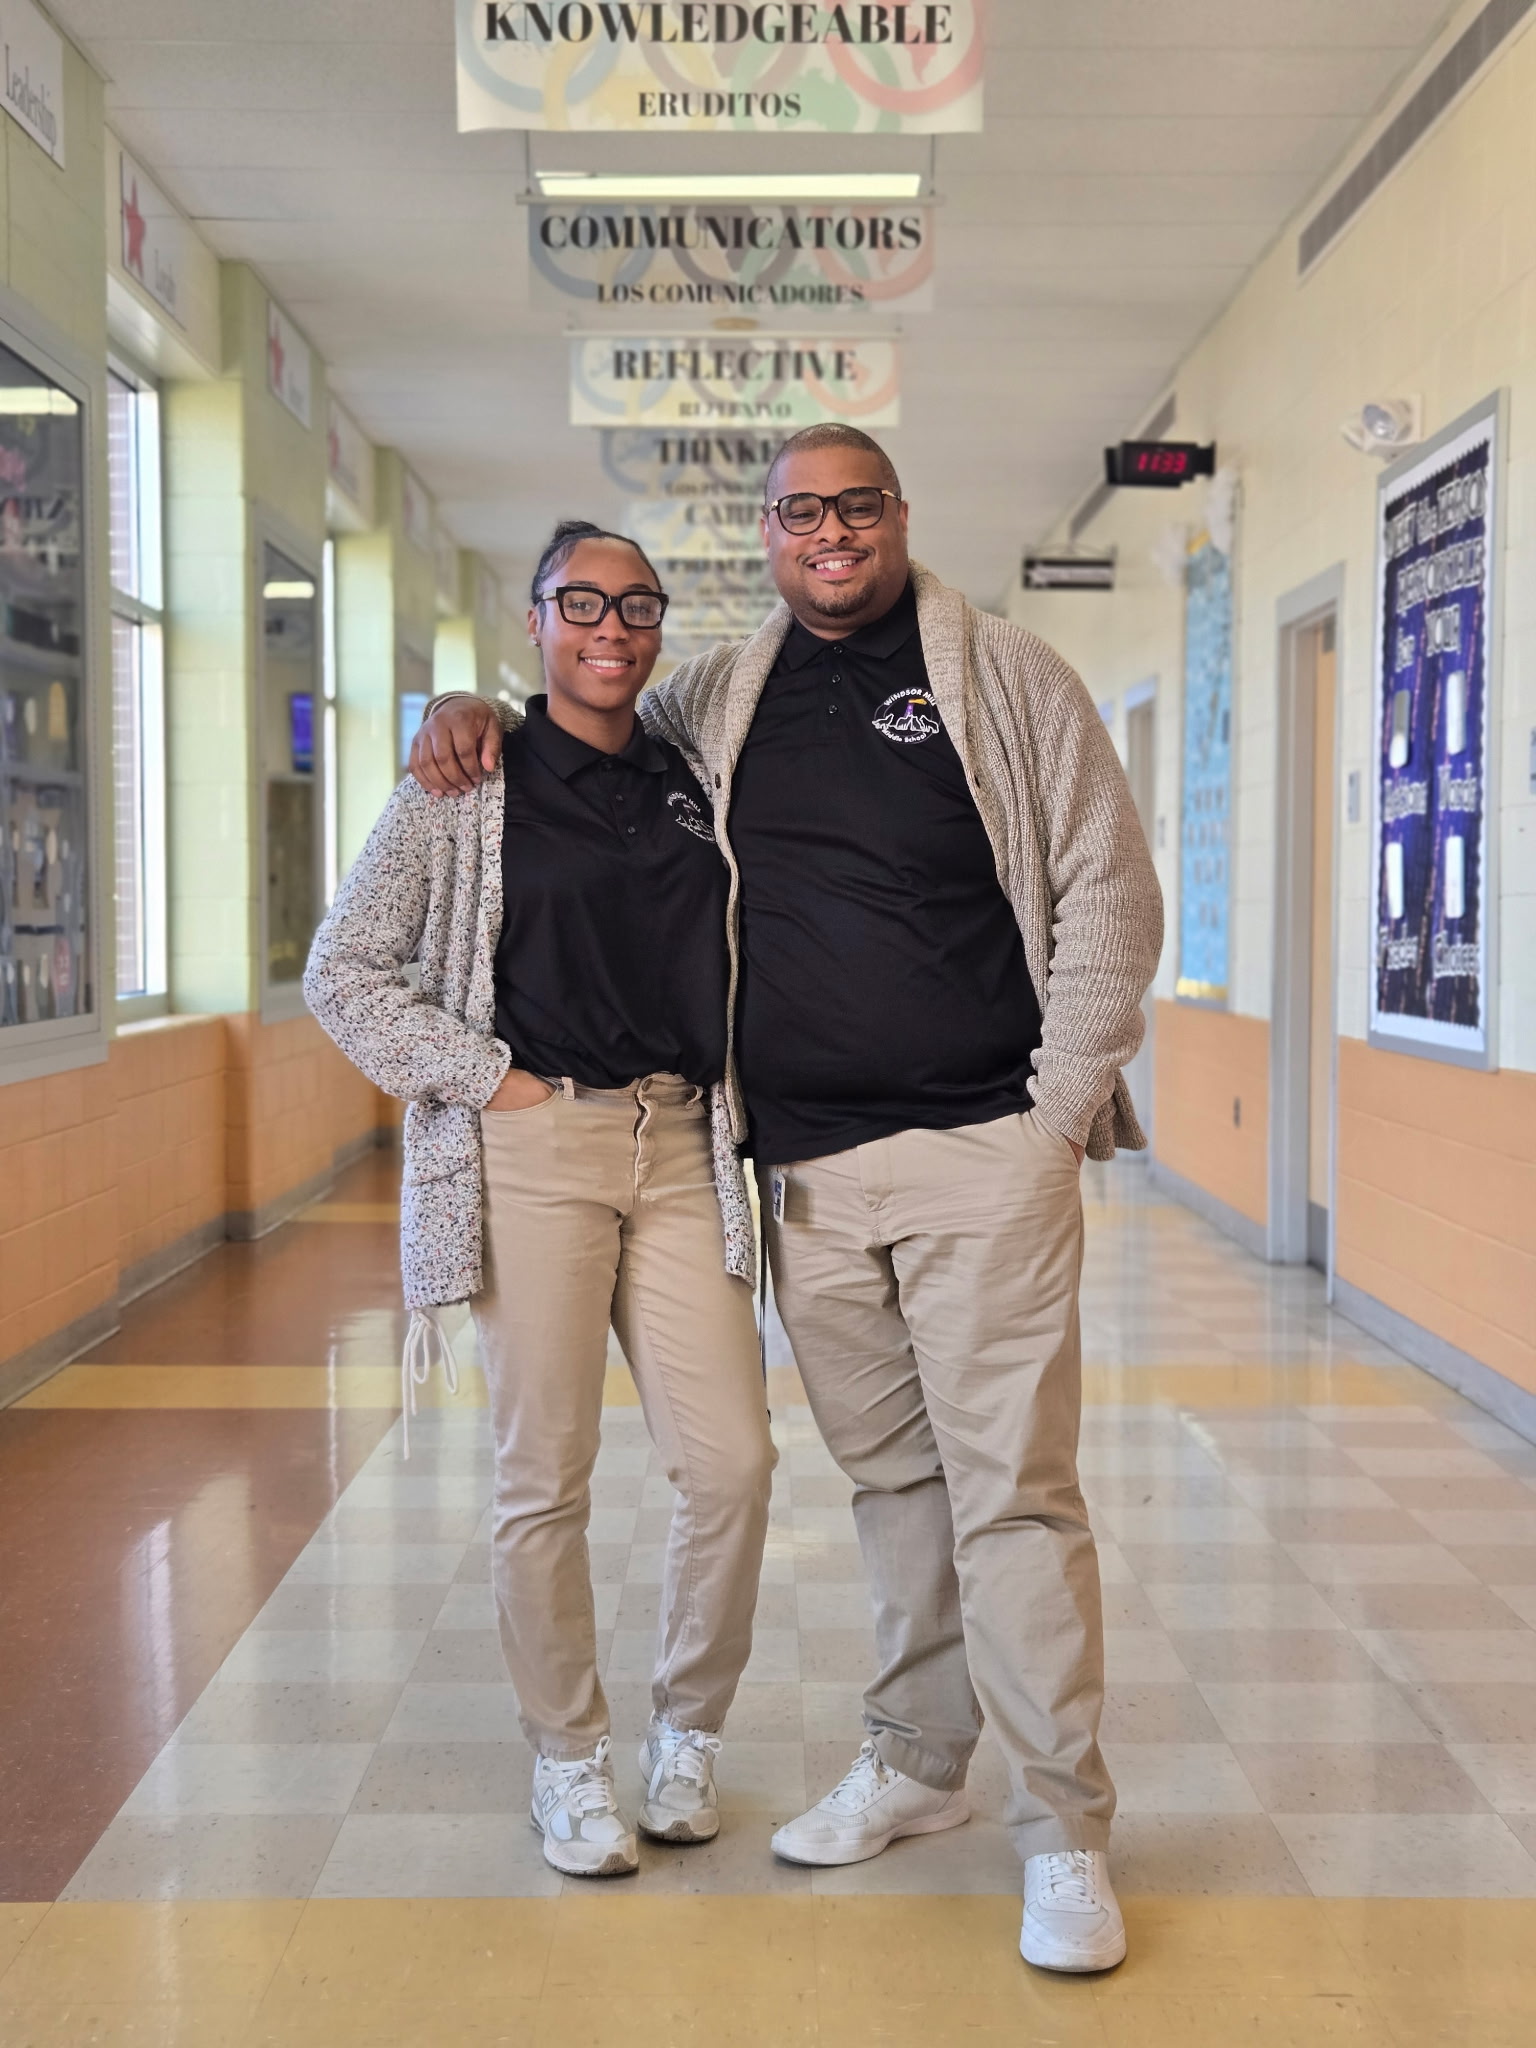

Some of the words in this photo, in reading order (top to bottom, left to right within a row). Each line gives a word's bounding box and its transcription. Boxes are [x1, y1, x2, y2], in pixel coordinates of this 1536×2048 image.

[485, 1, 953, 44] KNOWLEDGEABLE
[5, 44, 58, 157] Leadership
[638, 92, 802, 118] ERUDITOS
[540, 216, 922, 250] COMMUNICATORS
[597, 283, 645, 304] LOS
[649, 283, 865, 305] COMUNICADORES
[613, 349, 857, 381] REFLECTIVE
[884, 688, 922, 706] WINDSOR
[904, 732, 927, 743] School
